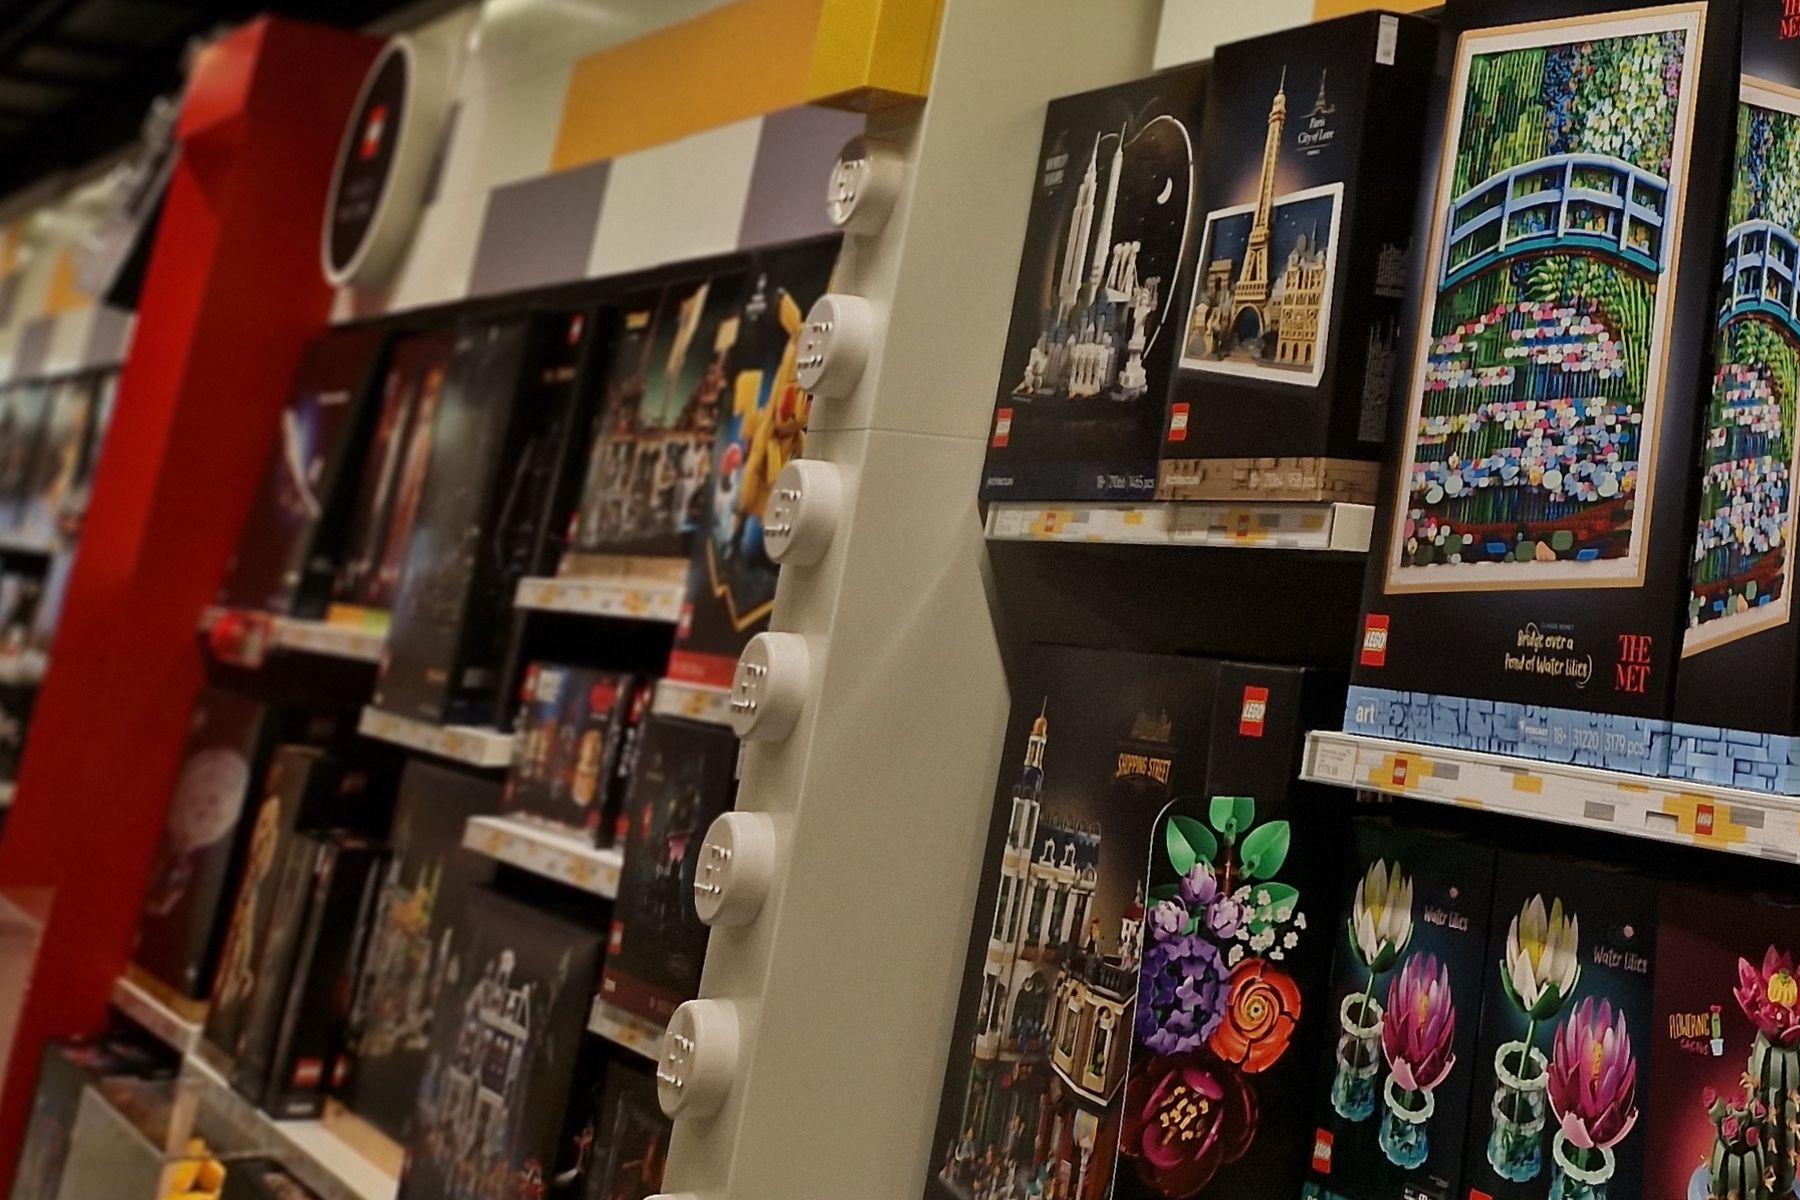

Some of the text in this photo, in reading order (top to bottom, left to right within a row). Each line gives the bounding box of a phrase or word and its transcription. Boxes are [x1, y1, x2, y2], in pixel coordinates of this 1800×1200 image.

[1364, 628, 1388, 651] LEGO
[1517, 627, 1574, 652] Bridge over a
[1618, 634, 1652, 663] THE
[1505, 652, 1588, 677] Pond of Water Lilies
[1614, 663, 1650, 693] MET
[1356, 703, 1376, 725] art
[1553, 726, 1567, 744] 18+
[1573, 728, 1599, 749] 31220
[1605, 732, 1626, 753] 3179
[1627, 741, 1645, 757] pcs
[1116, 753, 1171, 784] SHOPPING STREET
[1424, 905, 1448, 925] Water
[1594, 945, 1648, 974] Water Lilies
[1669, 1012, 1710, 1039] FLOWERING
